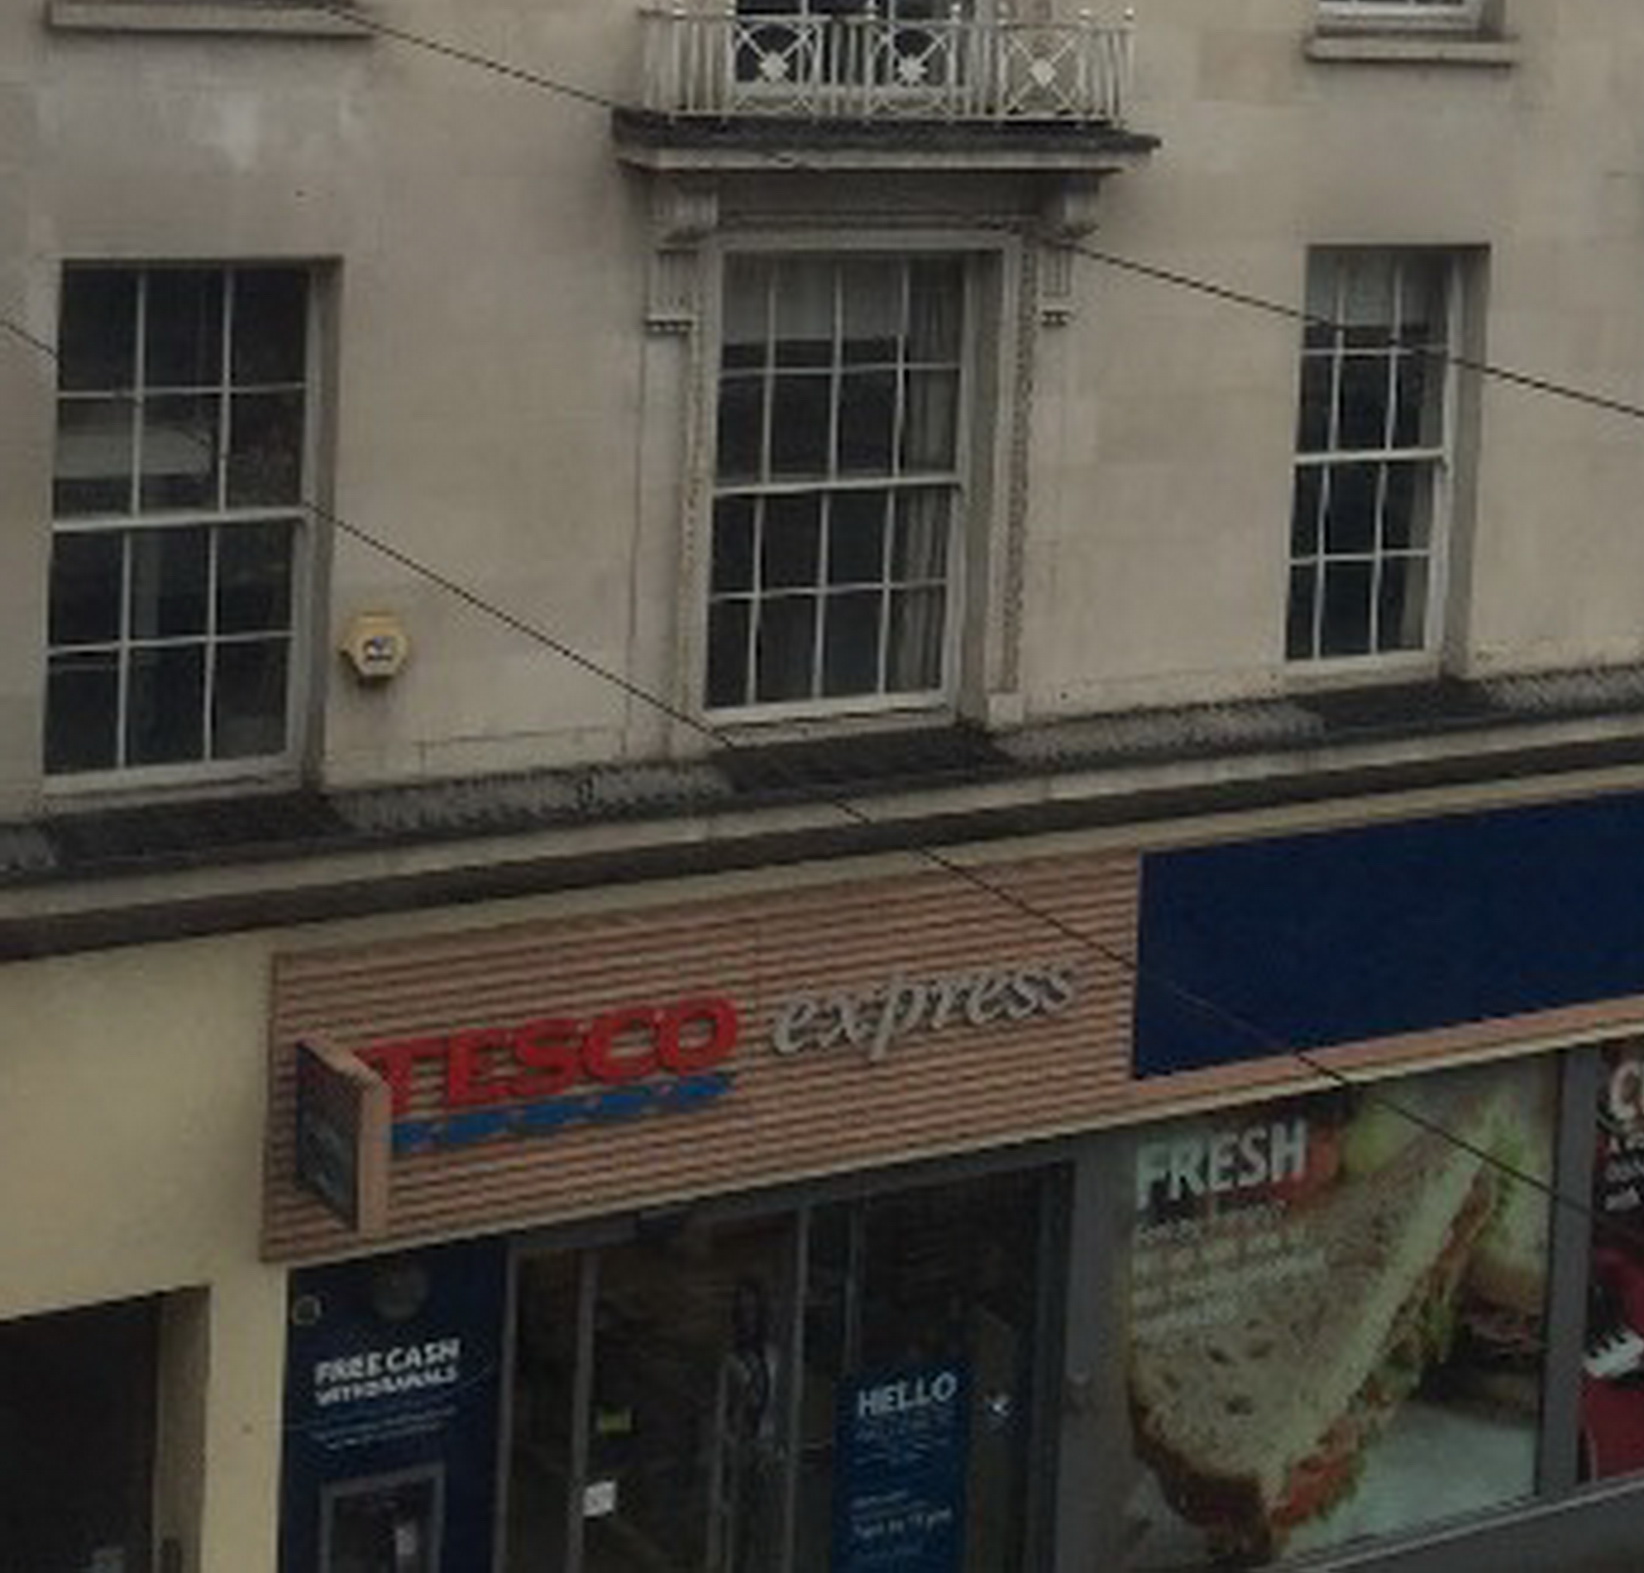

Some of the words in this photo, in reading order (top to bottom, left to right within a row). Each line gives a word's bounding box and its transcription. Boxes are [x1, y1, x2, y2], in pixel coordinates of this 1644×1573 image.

[355, 989, 738, 1117] TESCO
[773, 960, 1076, 1064] express
[1136, 1116, 1309, 1211] FRESH
[313, 1349, 384, 1385] FREE
[386, 1337, 461, 1371] CASH
[858, 1371, 959, 1418] HELLO
